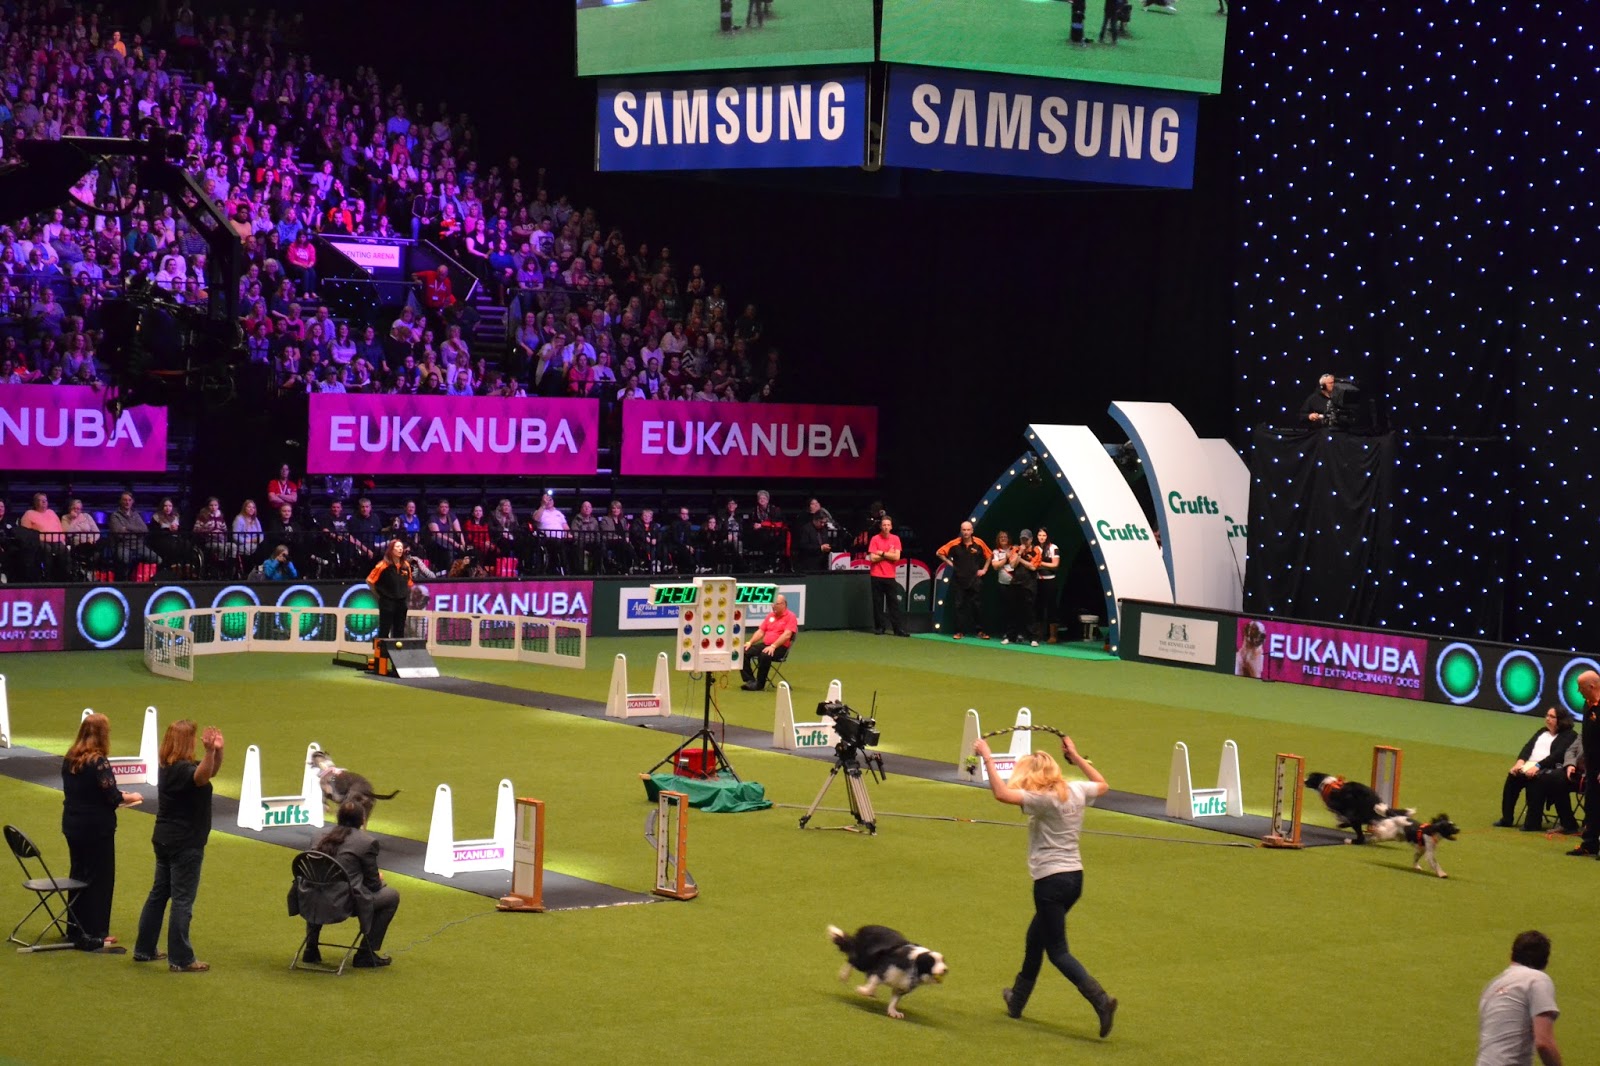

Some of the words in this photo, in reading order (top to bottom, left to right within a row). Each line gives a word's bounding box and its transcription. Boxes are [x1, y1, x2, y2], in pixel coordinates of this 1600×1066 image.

[613, 81, 846, 148] SAMSUNG
[909, 83, 1181, 163] SAMSUNG
[372, 252, 395, 260] ARENA
[329, 415, 578, 454] EUKANUBA
[641, 420, 859, 458] EUKANUBA
[1168, 490, 1219, 514] Crufts
[1096, 519, 1150, 541] Crufts
[434, 591, 588, 616] EUKANUBA
[1269, 633, 1420, 676] EUKANUBA
[1302, 665, 1322, 676] FUEL
[1324, 667, 1393, 685] EXTRAORDINARY
[1395, 676, 1420, 689] DOGS
[1192, 795, 1227, 815] rufts
